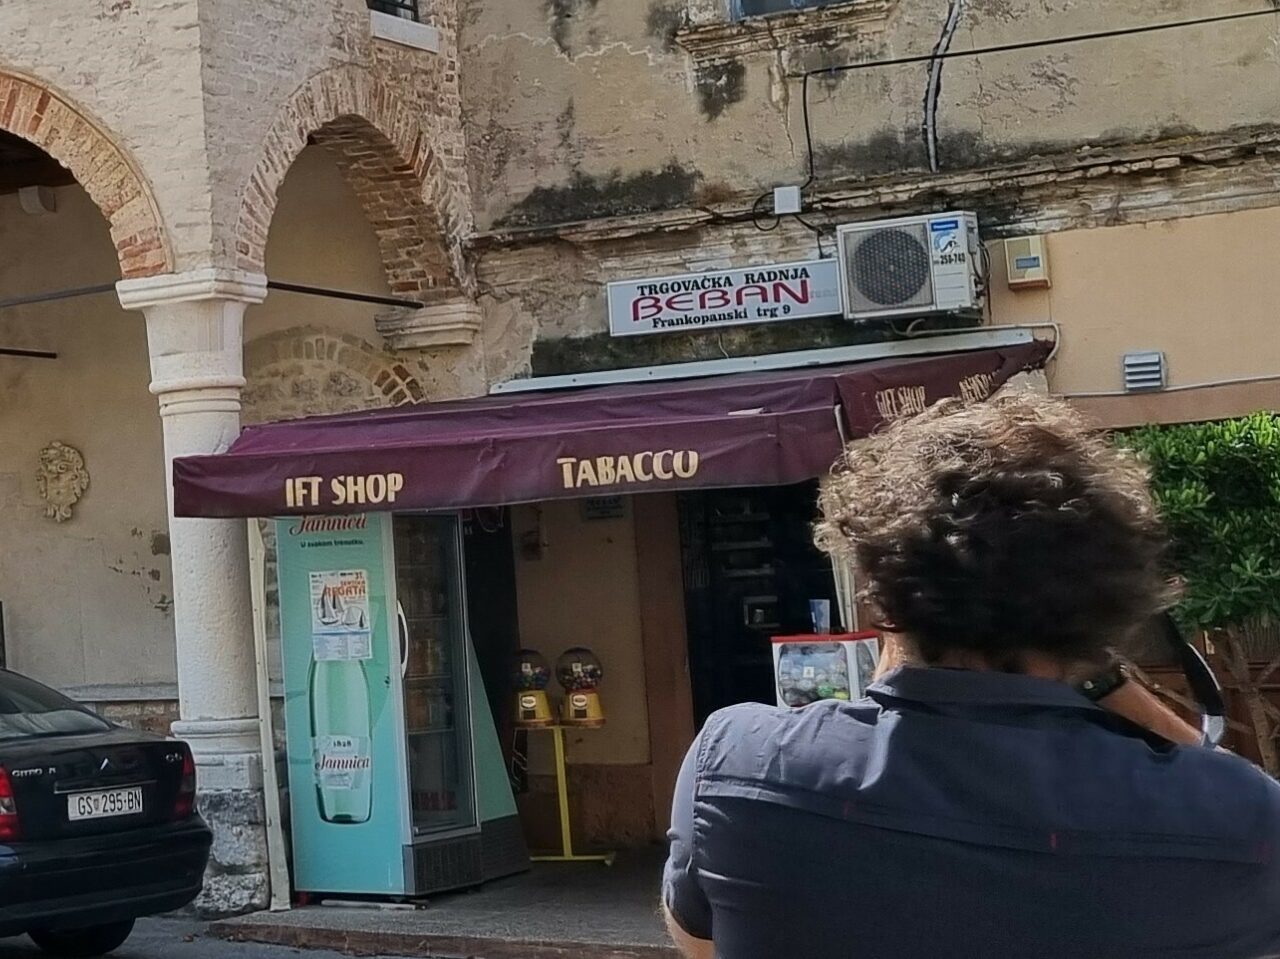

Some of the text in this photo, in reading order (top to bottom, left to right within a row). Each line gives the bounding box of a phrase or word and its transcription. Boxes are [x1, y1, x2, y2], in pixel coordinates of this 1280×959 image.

[636, 266, 811, 297] TRGOVAČKA RADNJA
[631, 278, 810, 322] BEBAN
[651, 304, 791, 329] Frankopanski trg 9
[556, 449, 699, 488] TABACCO
[330, 472, 404, 505] SHOP
[315, 753, 370, 770] Jamnica
[77, 796, 94, 816] GS
